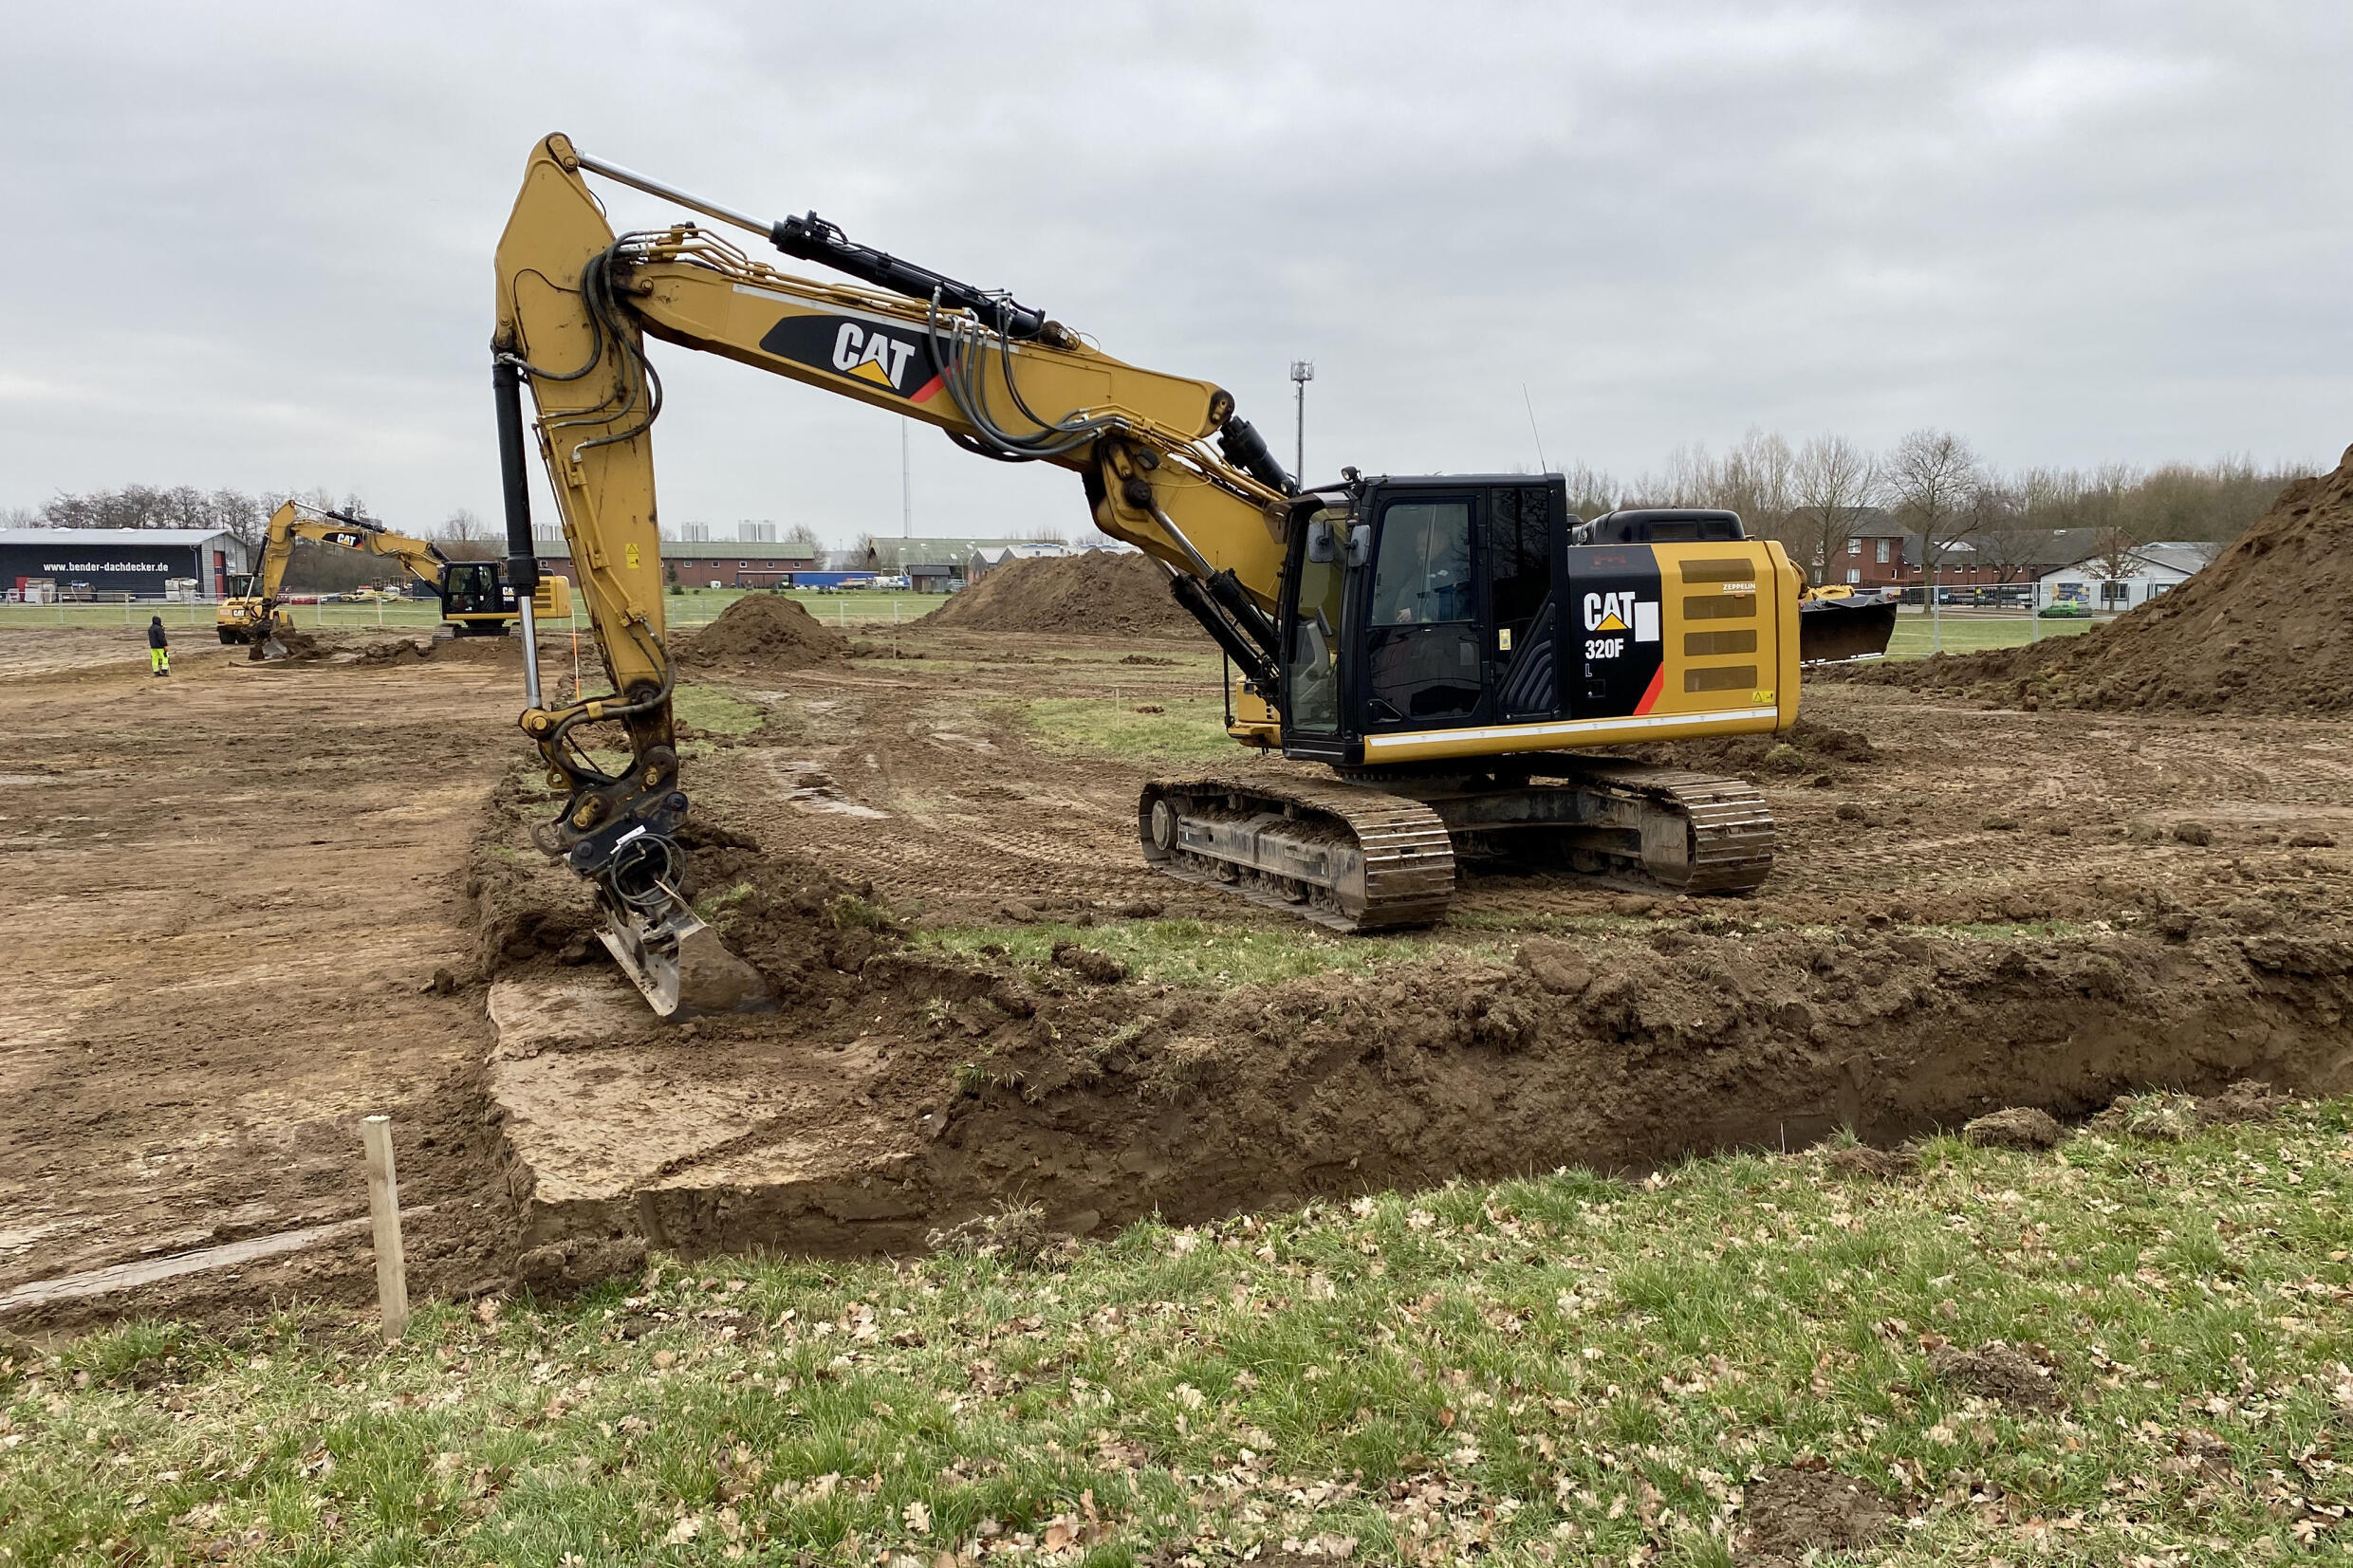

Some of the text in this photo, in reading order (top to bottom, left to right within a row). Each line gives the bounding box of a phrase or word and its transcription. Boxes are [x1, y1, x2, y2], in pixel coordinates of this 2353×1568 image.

[832, 323, 916, 390] CAT
[336, 533, 357, 547] CAT
[43, 562, 169, 572] www.bender-dachdecker.de
[502, 586, 515, 596] CA
[1722, 582, 1756, 591] ZEPPELIN
[1584, 591, 1636, 632] CAT
[1584, 638, 1624, 659] 320F
[1584, 663, 1593, 677] L
